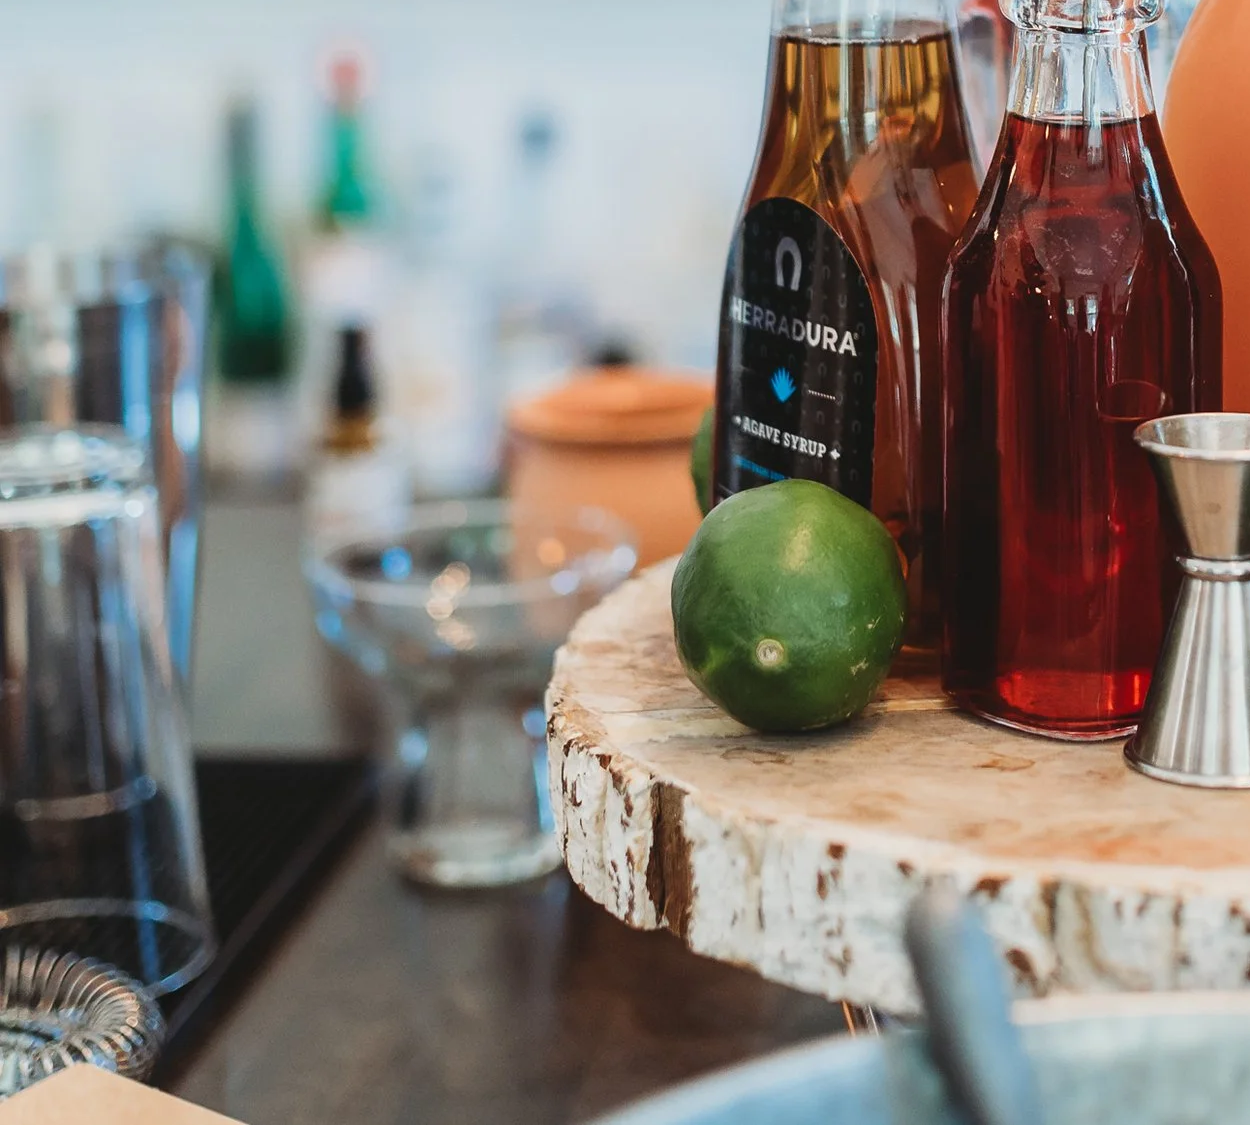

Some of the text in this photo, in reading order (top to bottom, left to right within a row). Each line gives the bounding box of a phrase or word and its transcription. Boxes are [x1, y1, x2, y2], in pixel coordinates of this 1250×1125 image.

[730, 296, 857, 357] HERRADURA
[742, 416, 827, 458] AGAVE SYRUP
